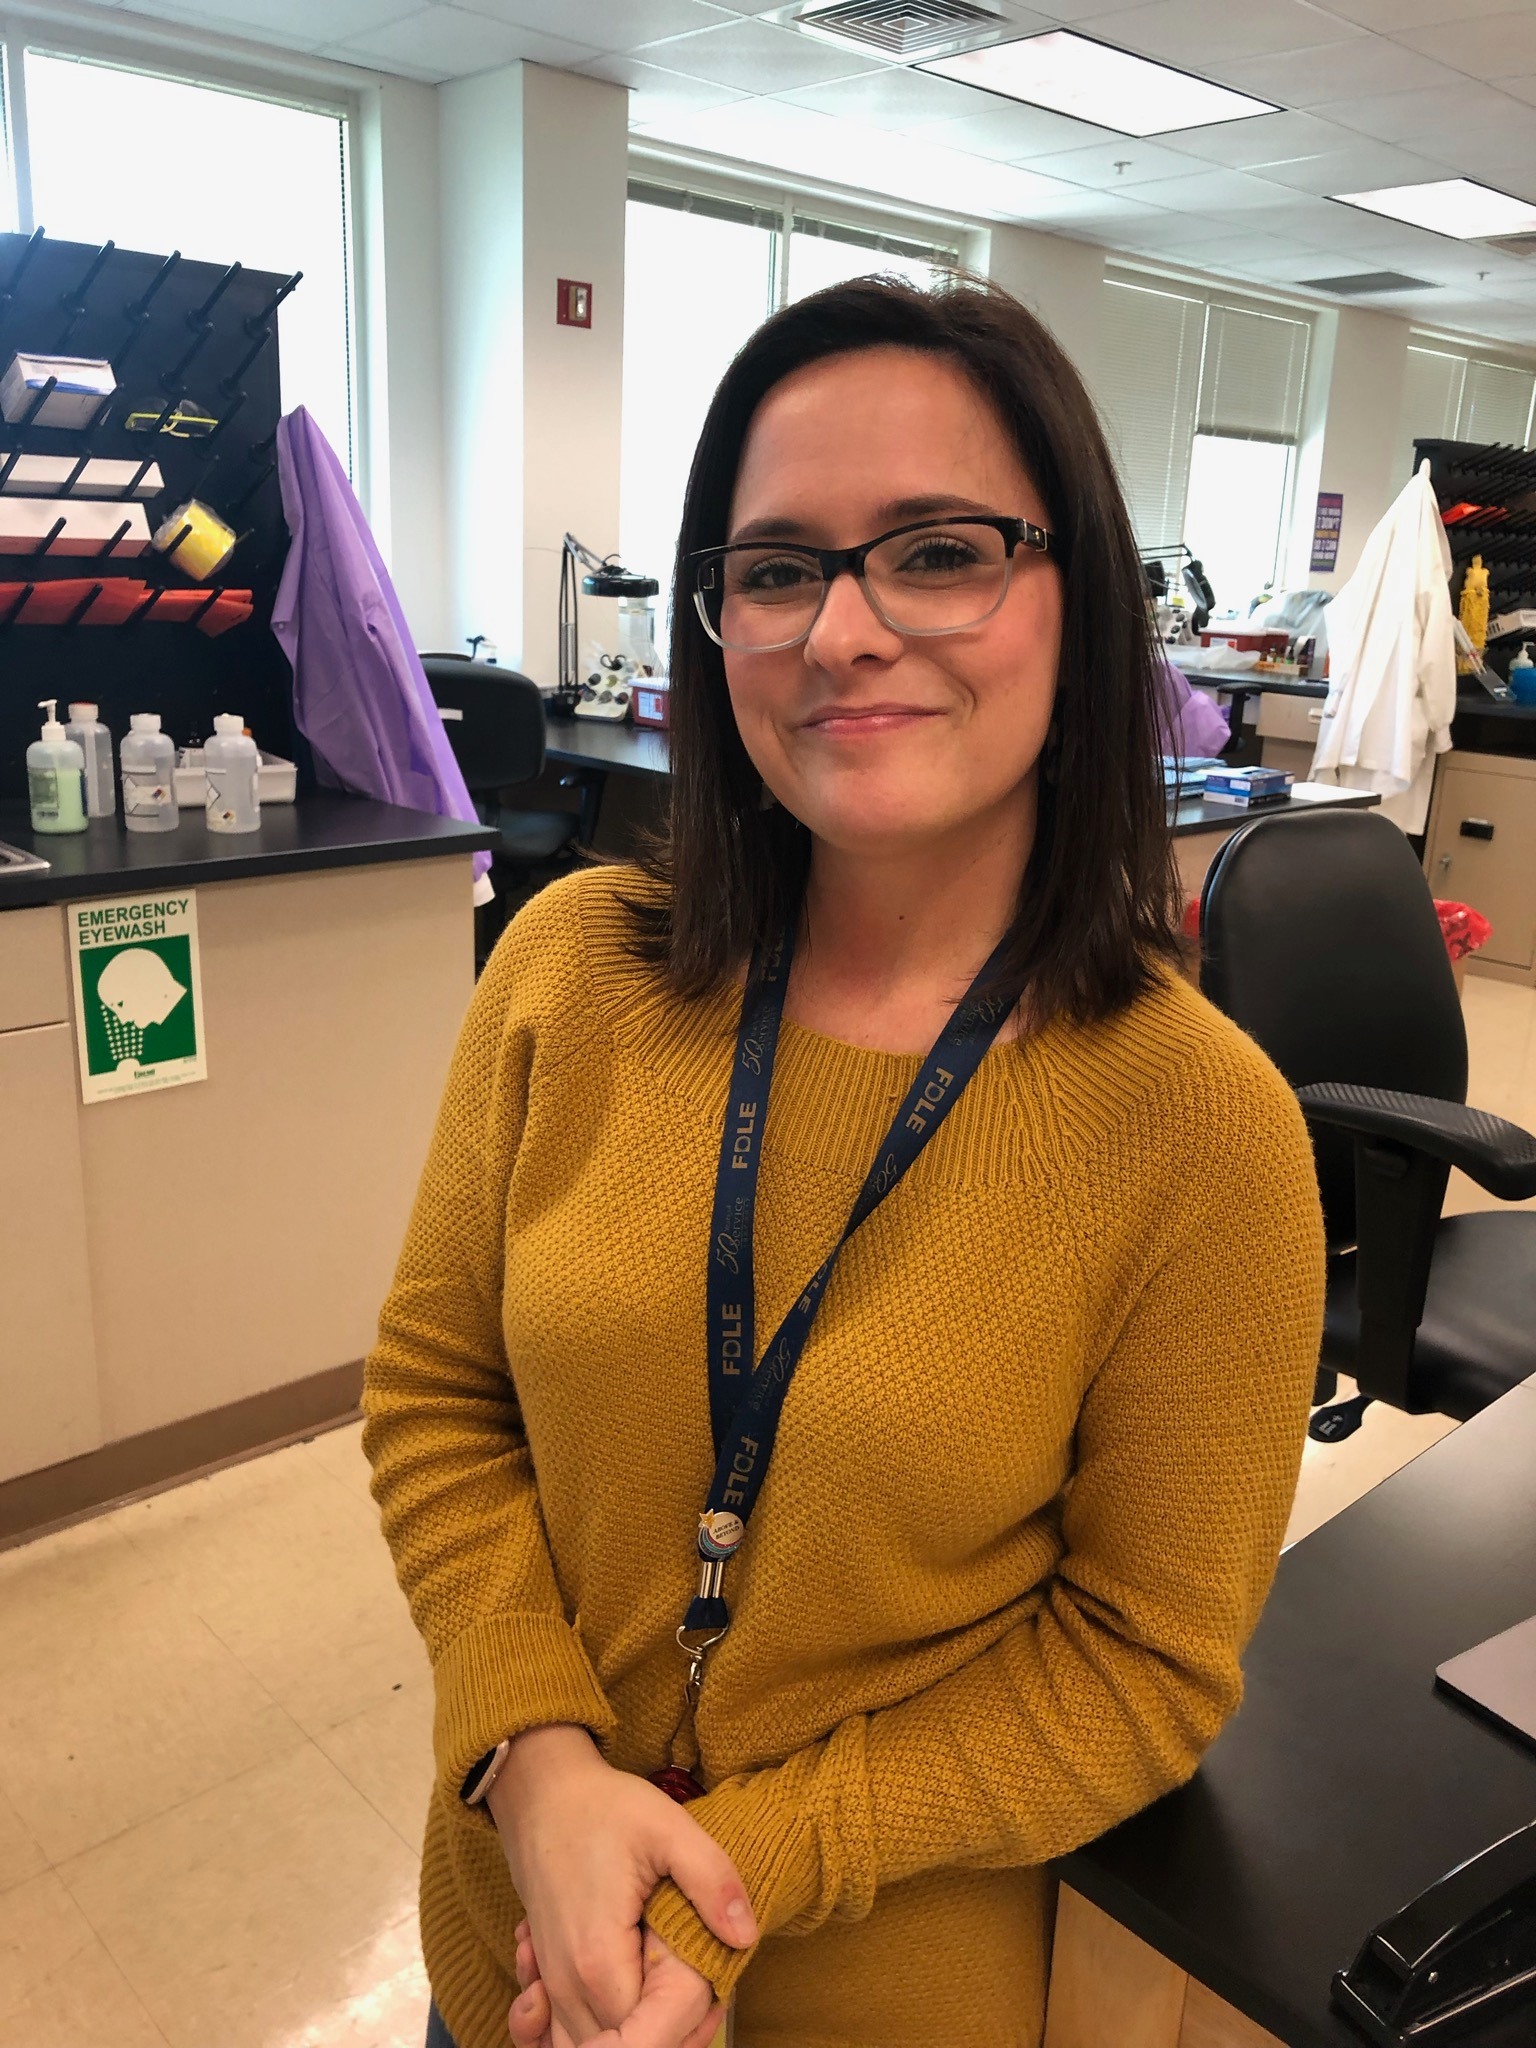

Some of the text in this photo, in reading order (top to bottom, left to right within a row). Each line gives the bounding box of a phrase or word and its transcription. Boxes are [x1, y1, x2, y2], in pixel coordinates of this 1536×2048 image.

[78, 899, 189, 928] EMERGENCY
[79, 920, 166, 946] EYEWASH
[742, 1038, 764, 1076] 50
[905, 1066, 955, 1135] FDLE
[731, 1101, 757, 1170] FDLE
[876, 1153, 898, 1193] 50
[730, 1197, 744, 1248] Service
[716, 1231, 739, 1275] 50
[722, 1303, 742, 1376] FDLE
[723, 1436, 759, 1506] FDLE
[715, 1526, 740, 1539] BEYOND
